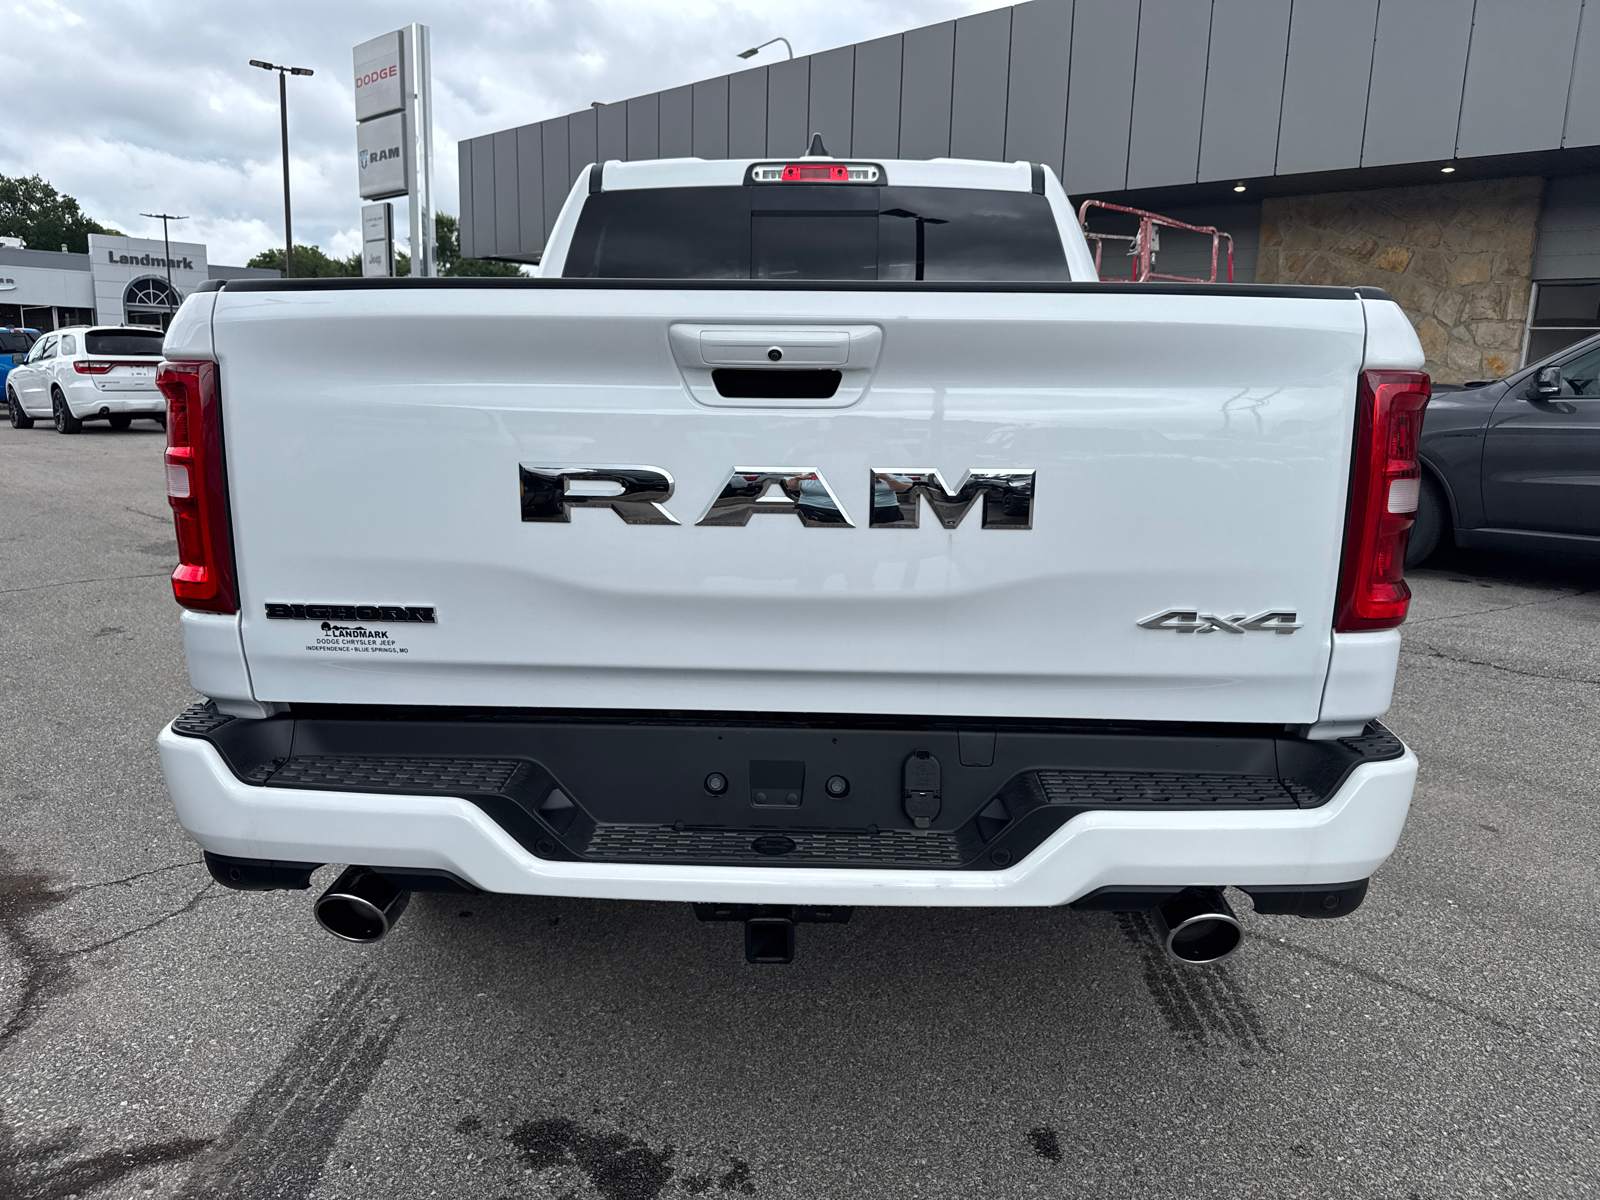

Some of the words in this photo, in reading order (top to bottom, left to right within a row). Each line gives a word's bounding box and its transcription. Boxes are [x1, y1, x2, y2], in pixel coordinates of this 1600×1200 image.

[356, 65, 397, 89] DODGE
[370, 147, 400, 163] RAM
[108, 250, 194, 270] Landmark
[518, 462, 1036, 530] RAM
[332, 630, 389, 639] LANDMARK
